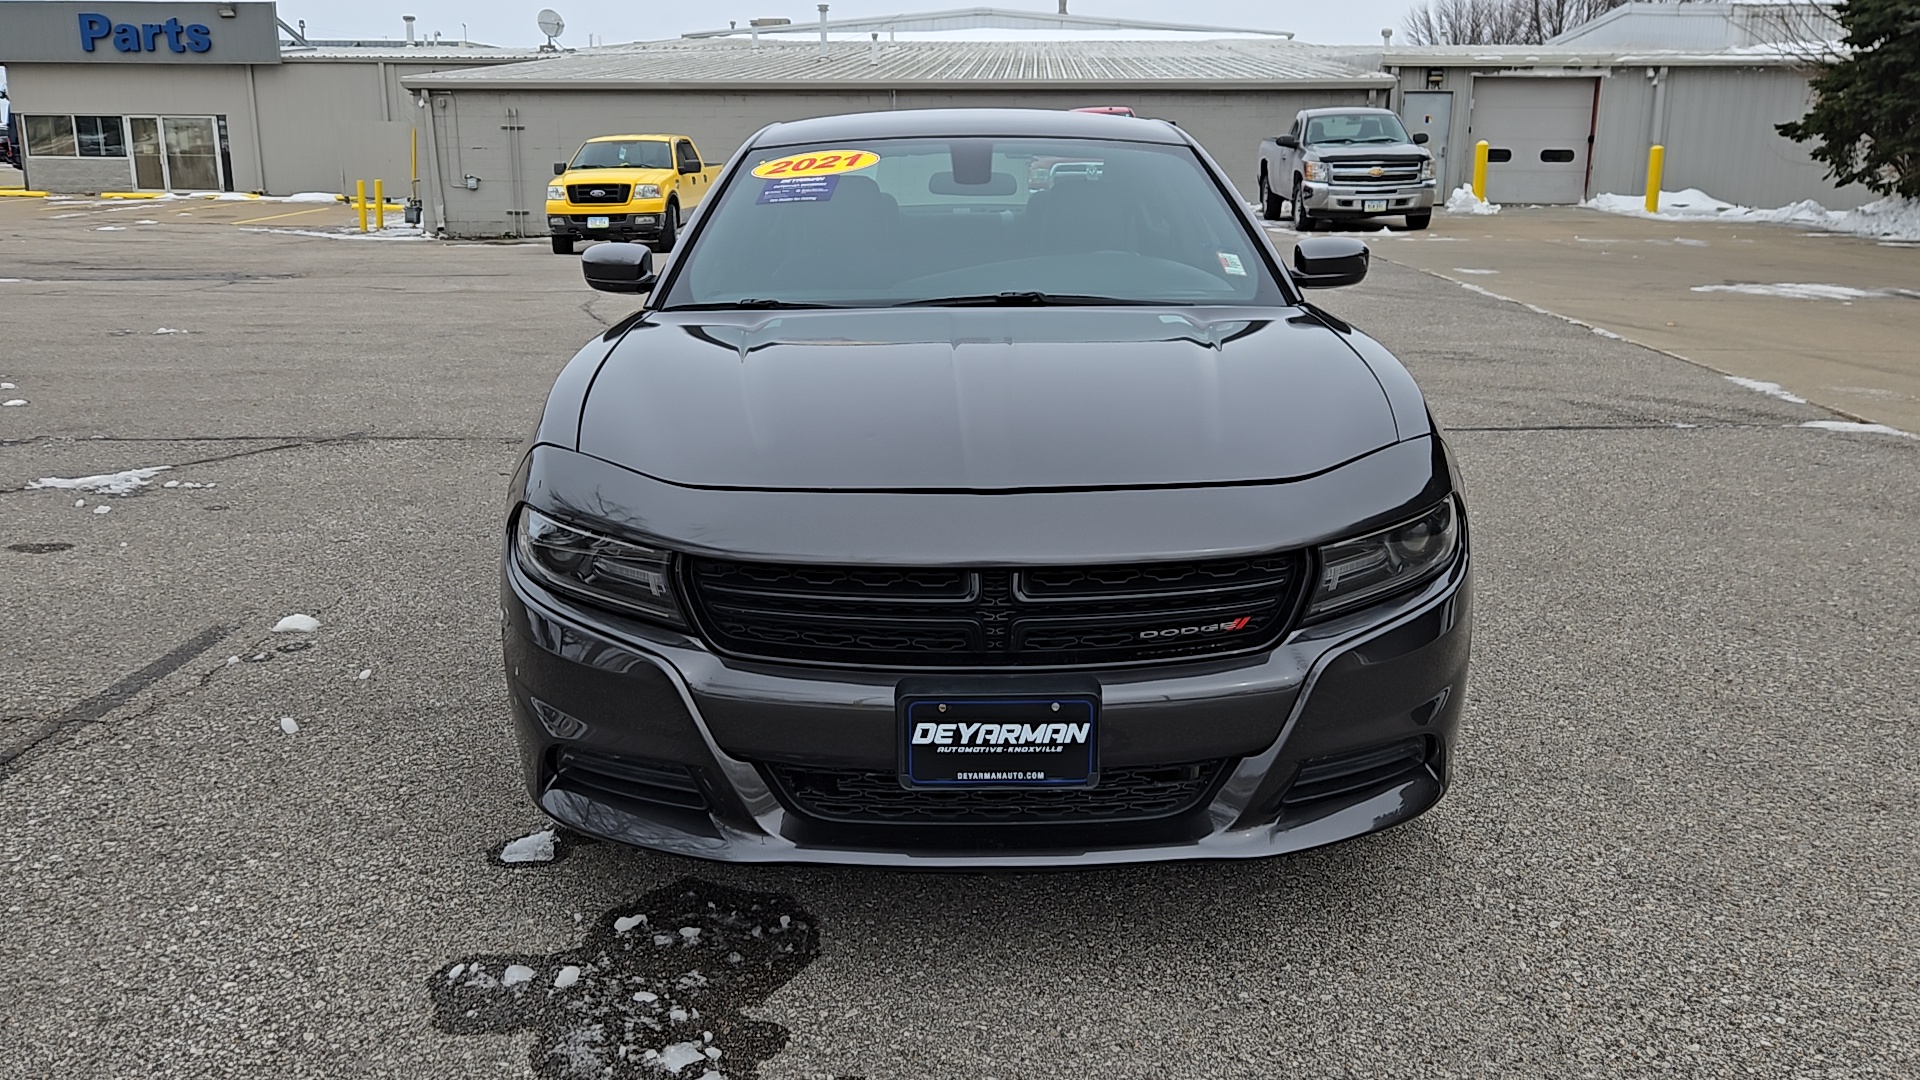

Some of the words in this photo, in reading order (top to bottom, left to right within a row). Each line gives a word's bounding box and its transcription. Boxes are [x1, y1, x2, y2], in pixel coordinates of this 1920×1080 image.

[78, 13, 212, 53] Parts
[764, 153, 864, 175] 2021
[1140, 621, 1237, 638] DODGE
[911, 723, 1091, 744] DEYARMAN
[957, 772, 1045, 780] DEYARMANAUTO.COM
